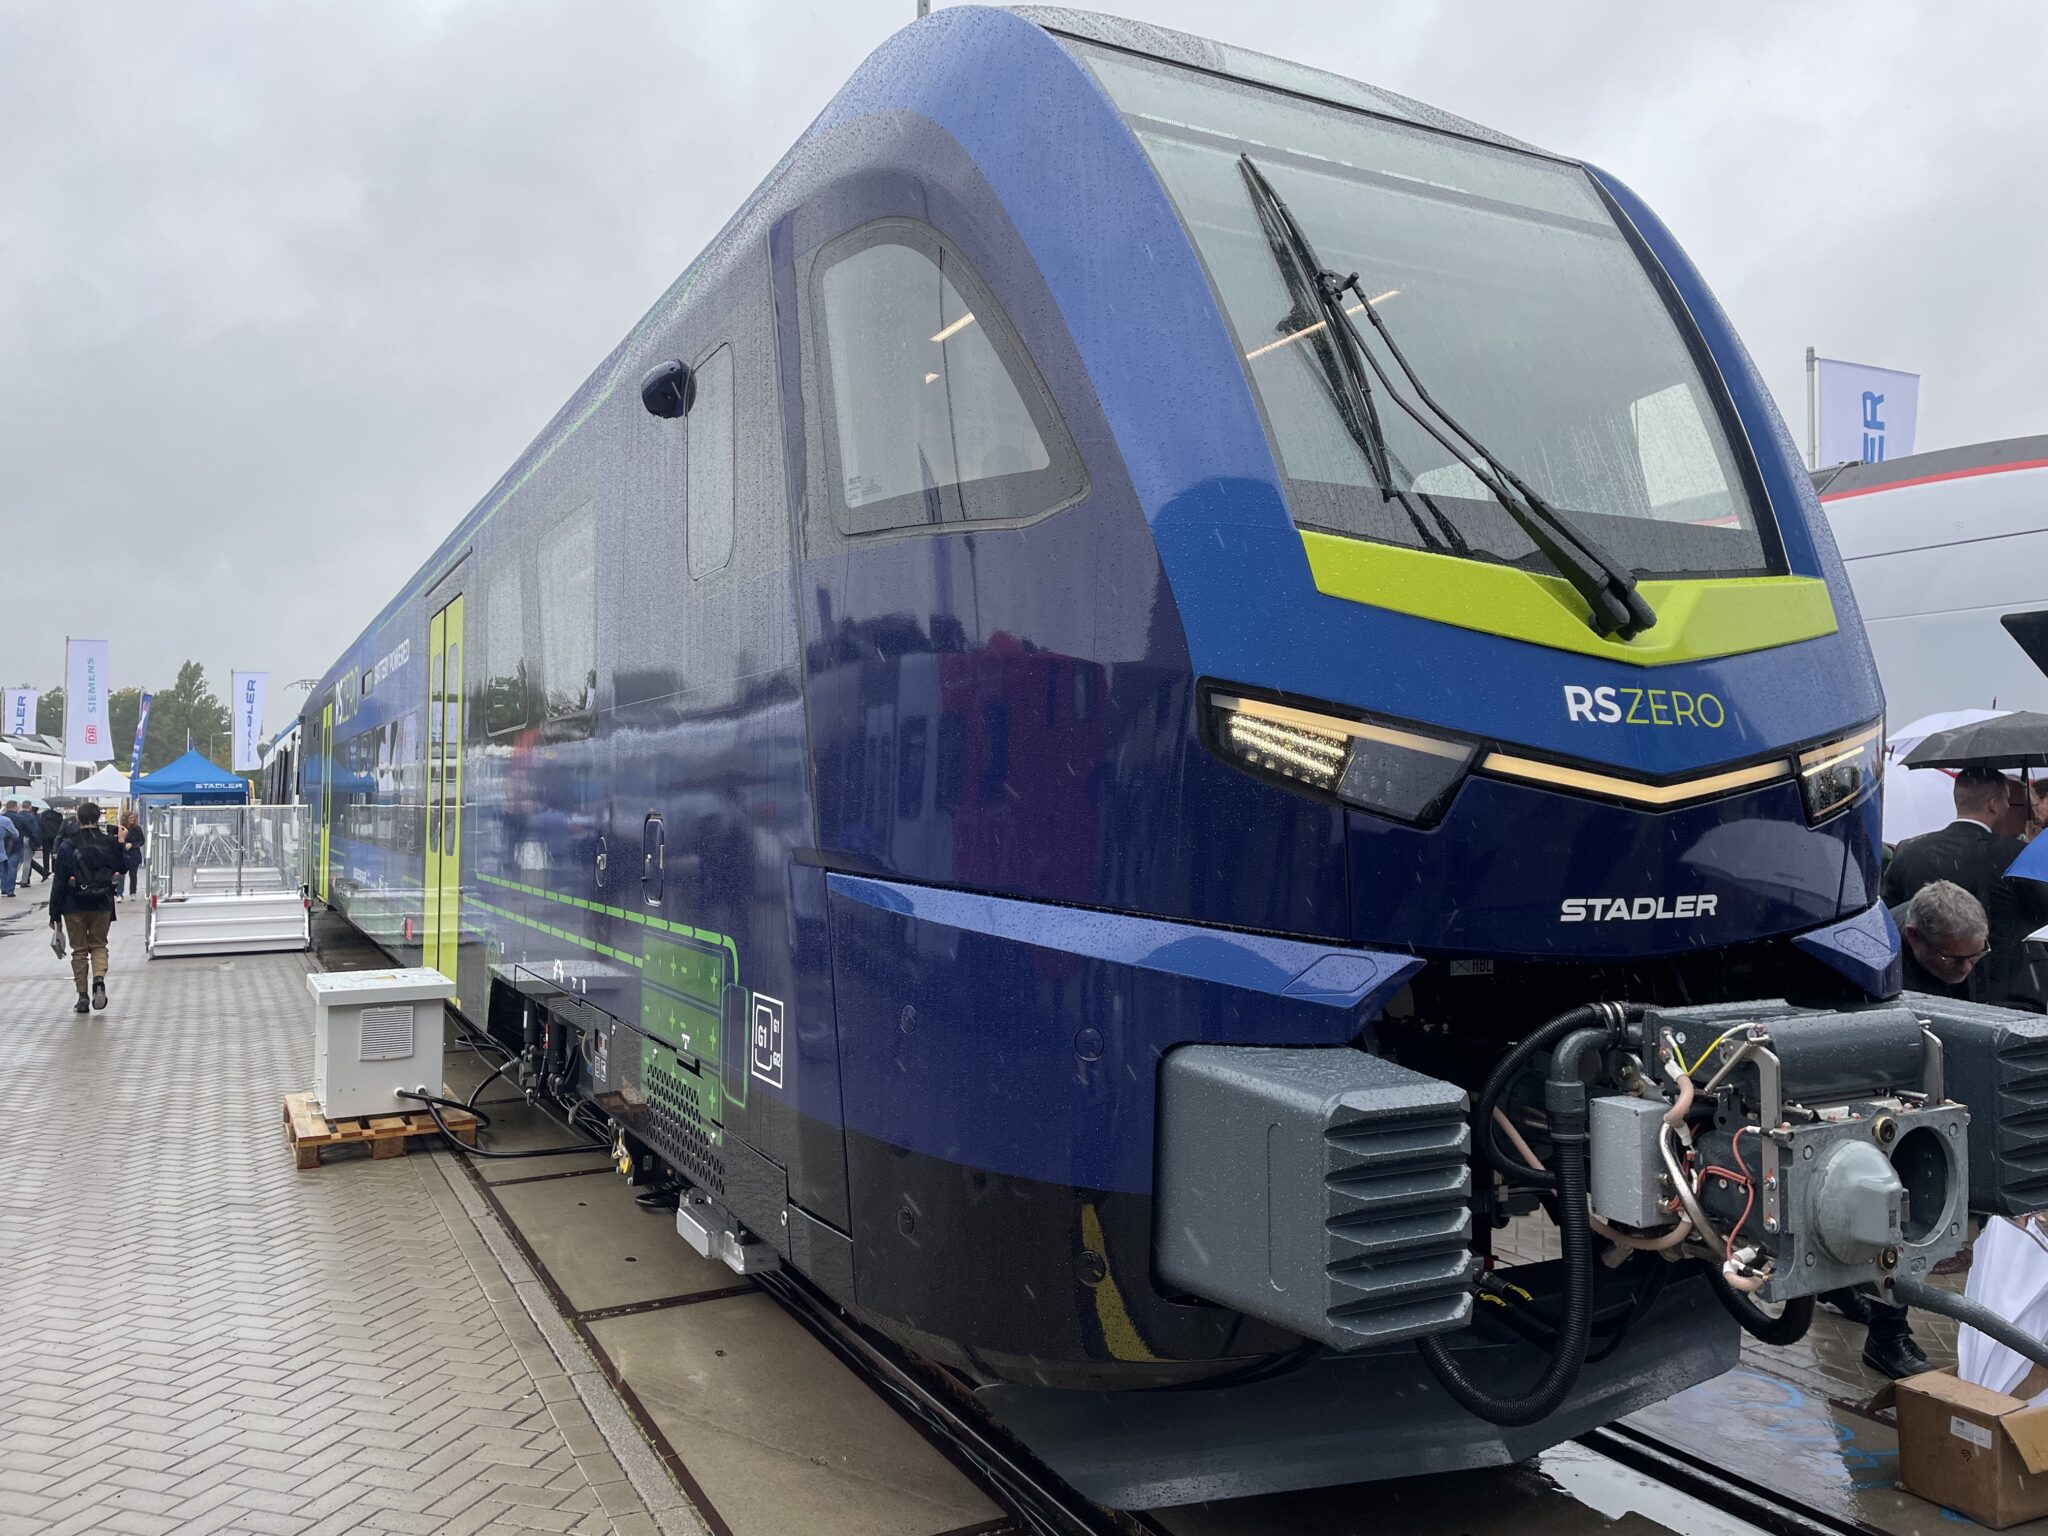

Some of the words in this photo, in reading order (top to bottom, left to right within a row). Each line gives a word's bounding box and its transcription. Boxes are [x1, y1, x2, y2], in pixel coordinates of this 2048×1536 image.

[87, 657, 97, 713] SIEMENS
[1563, 685, 1725, 729] RSZERO
[87, 725, 97, 743] DB
[1560, 894, 1718, 922] STADLER
[758, 1025, 767, 1048] G1
